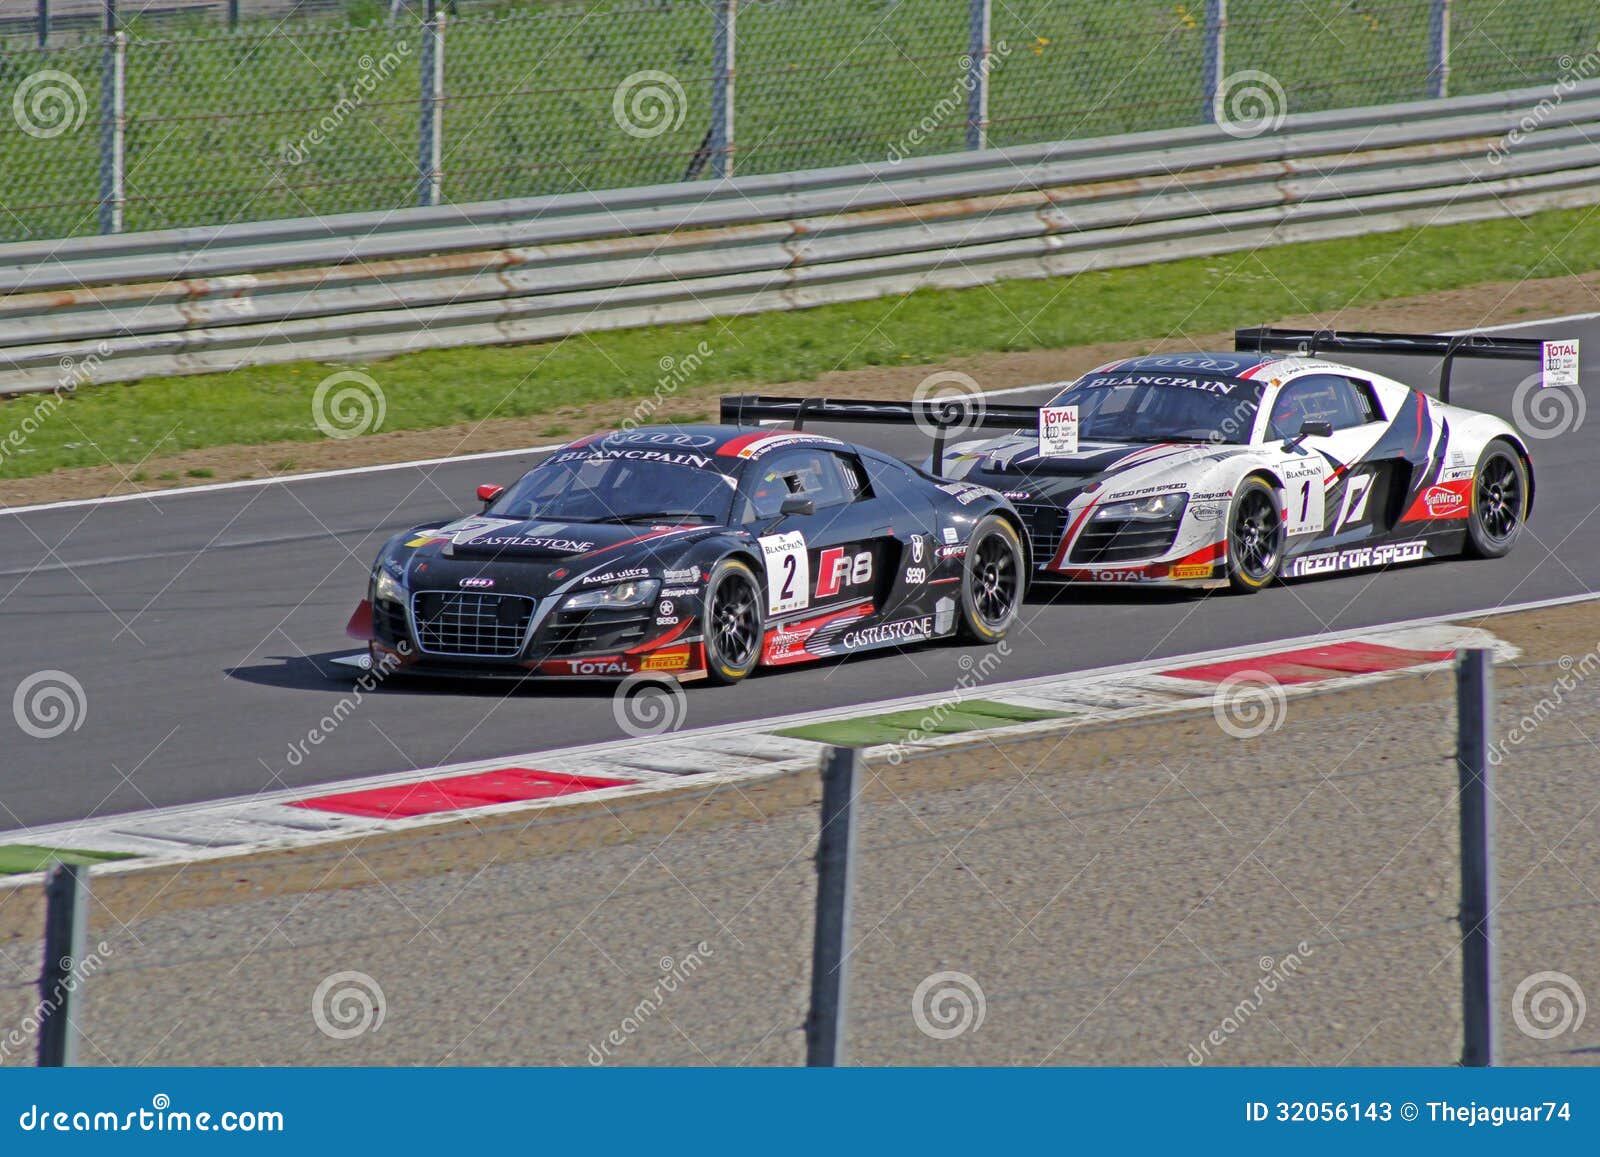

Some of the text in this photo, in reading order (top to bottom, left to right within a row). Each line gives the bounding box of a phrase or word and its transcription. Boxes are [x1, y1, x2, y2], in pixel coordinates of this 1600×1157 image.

[1546, 344, 1577, 356] TOTAL
[1087, 376, 1237, 395] BLANCPAIN
[1042, 410, 1076, 424] TOTAL
[557, 450, 712, 468] BLANCPAIN
[1286, 466, 1322, 479] BLANCPAIN
[1109, 483, 1187, 499] NEED FOR SPEED
[1301, 480, 1310, 522] 1
[468, 536, 594, 551] CASTLESTONE
[765, 539, 803, 555] BLANCPAIN
[1294, 540, 1427, 576] NEED FOR SPEED
[582, 572, 615, 584] Audi
[616, 568, 649, 578] ultra
[780, 554, 796, 600] 2
[829, 551, 873, 590] R8
[1088, 568, 1152, 581] TOTAL
[843, 617, 932, 649] CASTLESTONE
[567, 660, 633, 674] TOTAL
